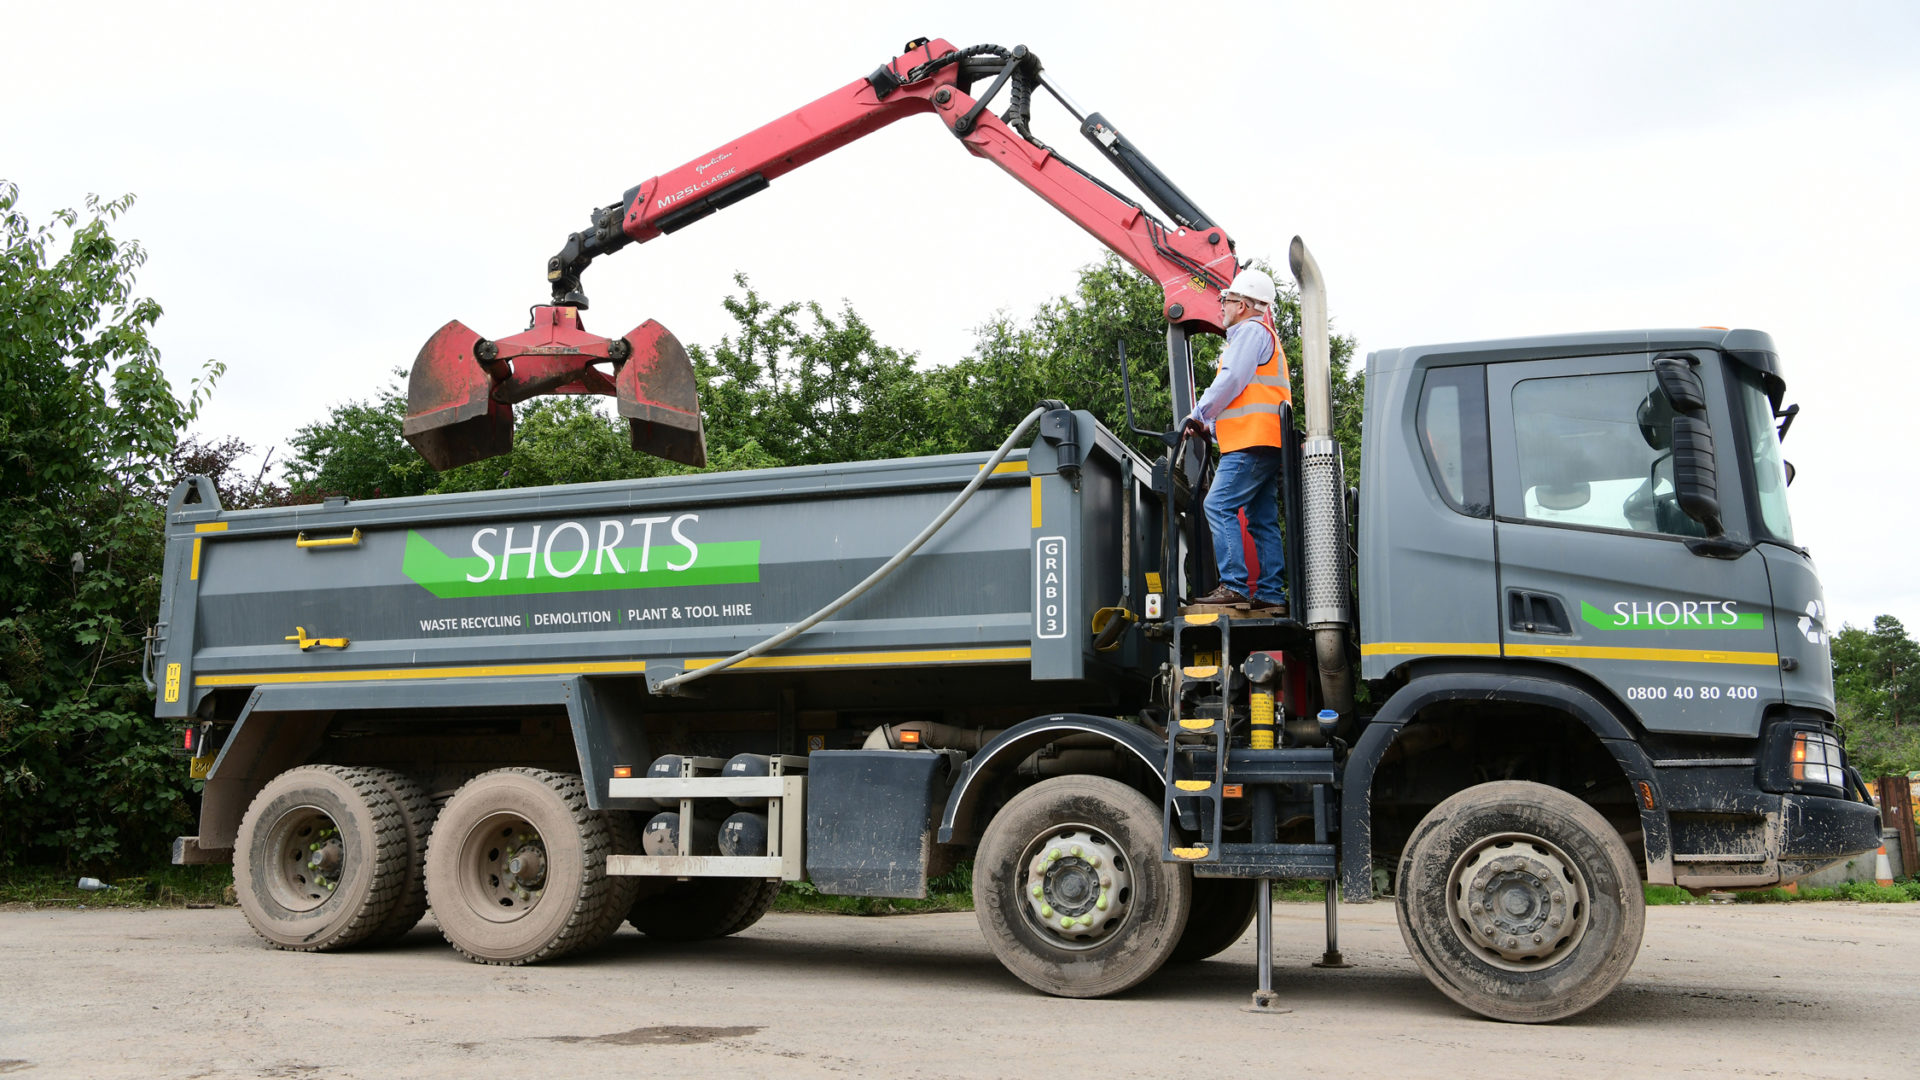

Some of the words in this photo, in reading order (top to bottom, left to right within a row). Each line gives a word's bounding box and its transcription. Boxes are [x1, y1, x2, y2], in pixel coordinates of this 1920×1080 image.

[657, 183, 701, 209] M125L
[701, 166, 736, 188] CLASSIC
[466, 514, 699, 583] SHORTS
[1045, 543, 1058, 599] GRAB
[419, 618, 458, 631] WASTE
[461, 615, 521, 629] RECYCLING
[534, 611, 611, 626] DEMOLITION
[628, 608, 668, 621] PLANT
[671, 606, 682, 619] &
[684, 605, 719, 618] TOOL
[722, 603, 753, 616] HIRE
[1046, 604, 1057, 631] 03
[1613, 601, 1739, 626] SHORTS
[1627, 686, 1667, 699] 0800
[1673, 686, 1694, 699] 40
[1700, 686, 1720, 699] 80
[1727, 686, 1758, 699] 400
